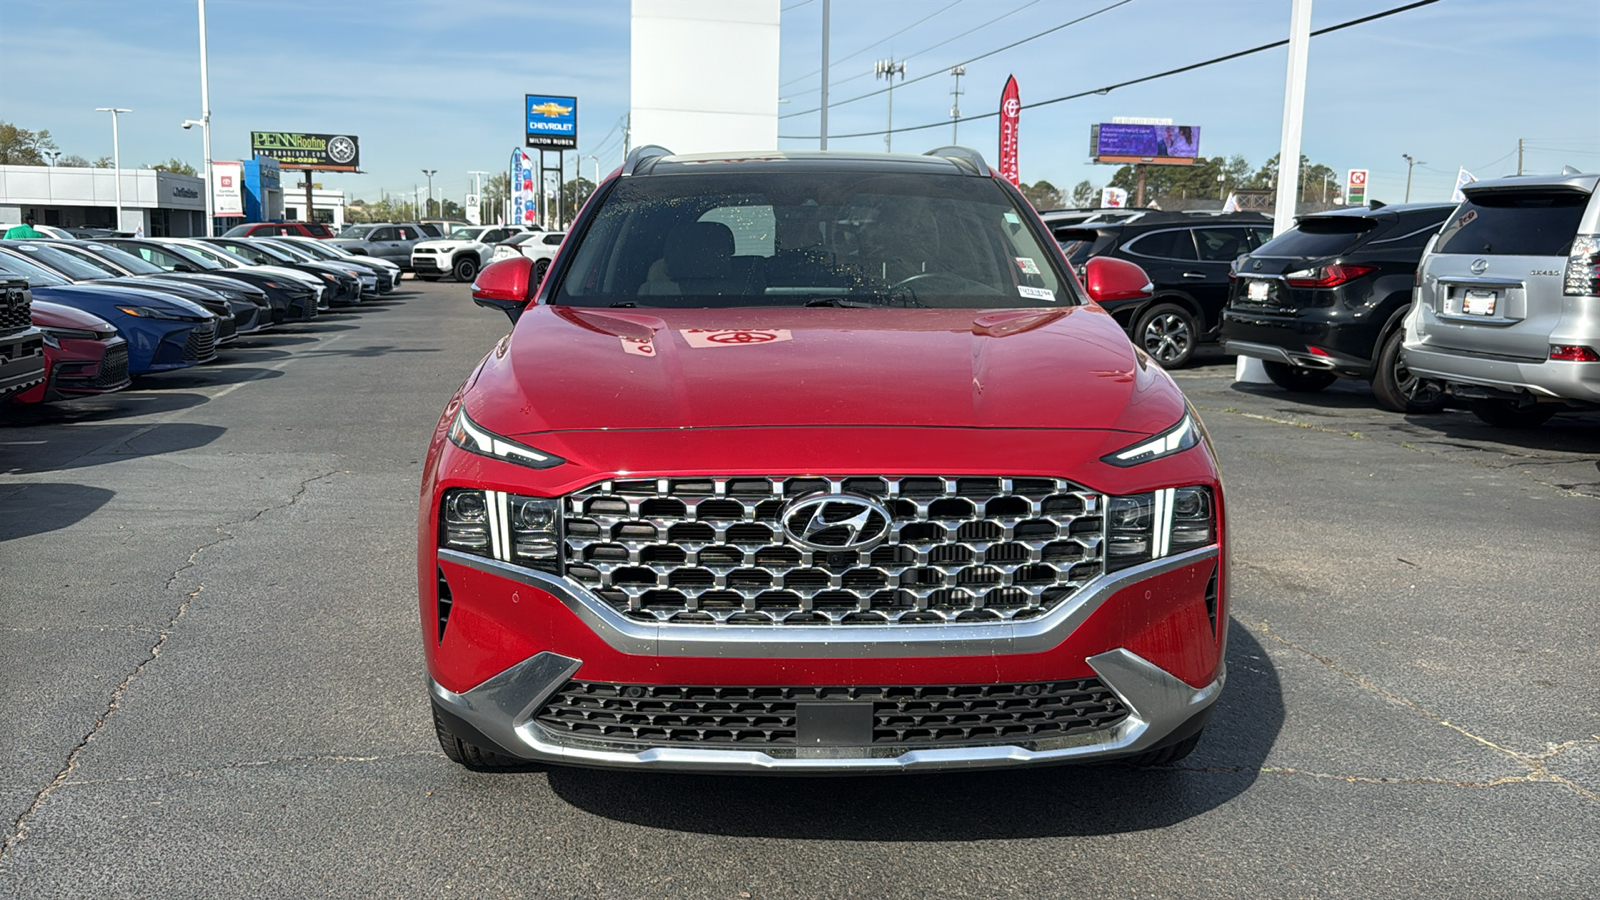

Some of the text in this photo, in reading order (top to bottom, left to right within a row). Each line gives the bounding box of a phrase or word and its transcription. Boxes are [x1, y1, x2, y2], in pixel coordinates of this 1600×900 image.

[530, 122, 573, 131] CHEVROLET
[253, 132, 301, 147] PENN
[297, 136, 326, 150] Roofing
[514, 153, 522, 192] USED
